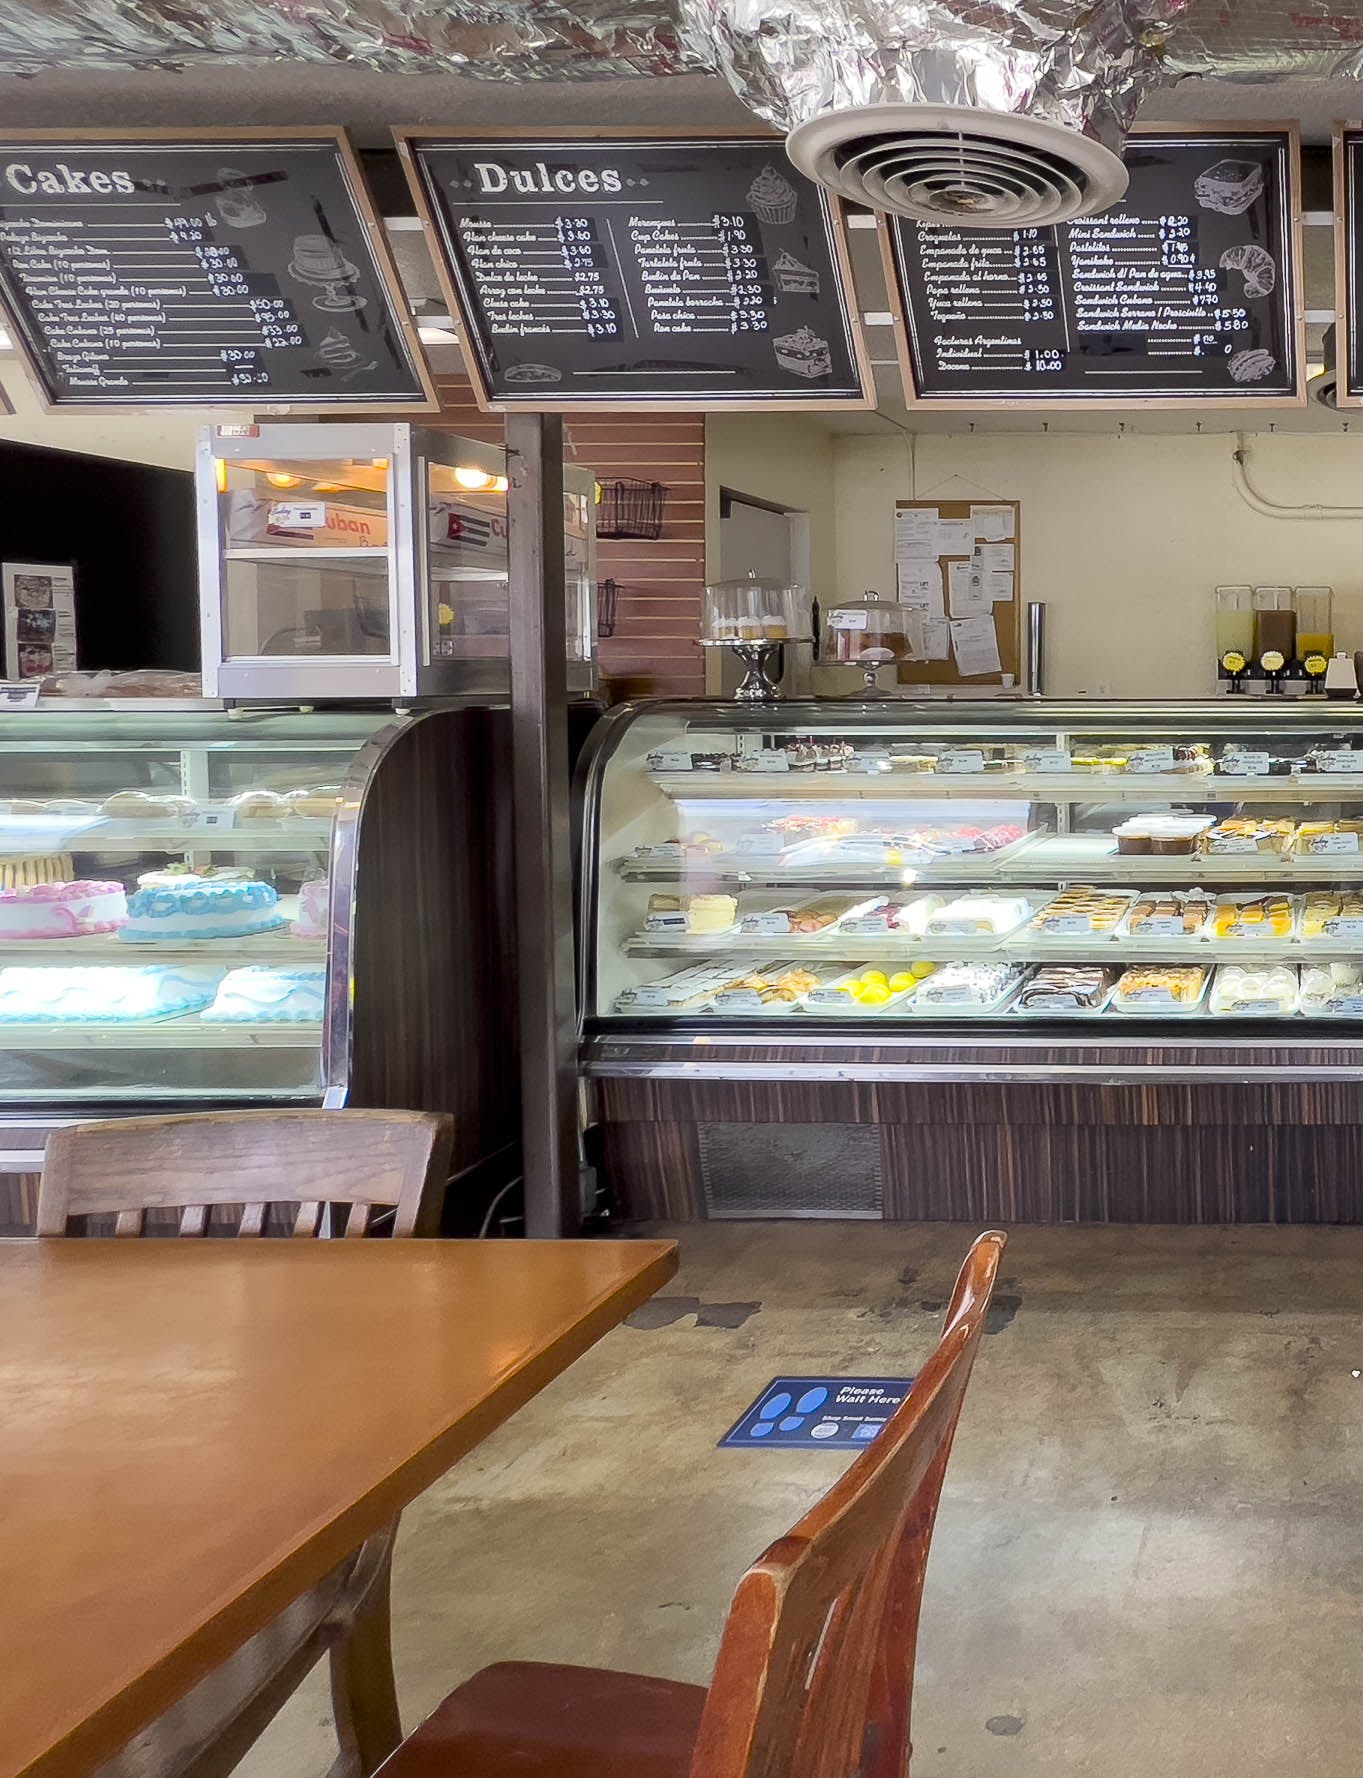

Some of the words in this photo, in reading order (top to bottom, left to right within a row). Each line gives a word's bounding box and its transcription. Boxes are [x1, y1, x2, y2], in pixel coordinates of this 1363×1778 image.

[5, 163, 135, 194] Cakes
[473, 163, 623, 194] Dulces
[325, 513, 371, 534] uban
[835, 1395, 865, 1403] Wait
[868, 1396, 901, 1404] Here
[840, 1386, 884, 1395] Please
